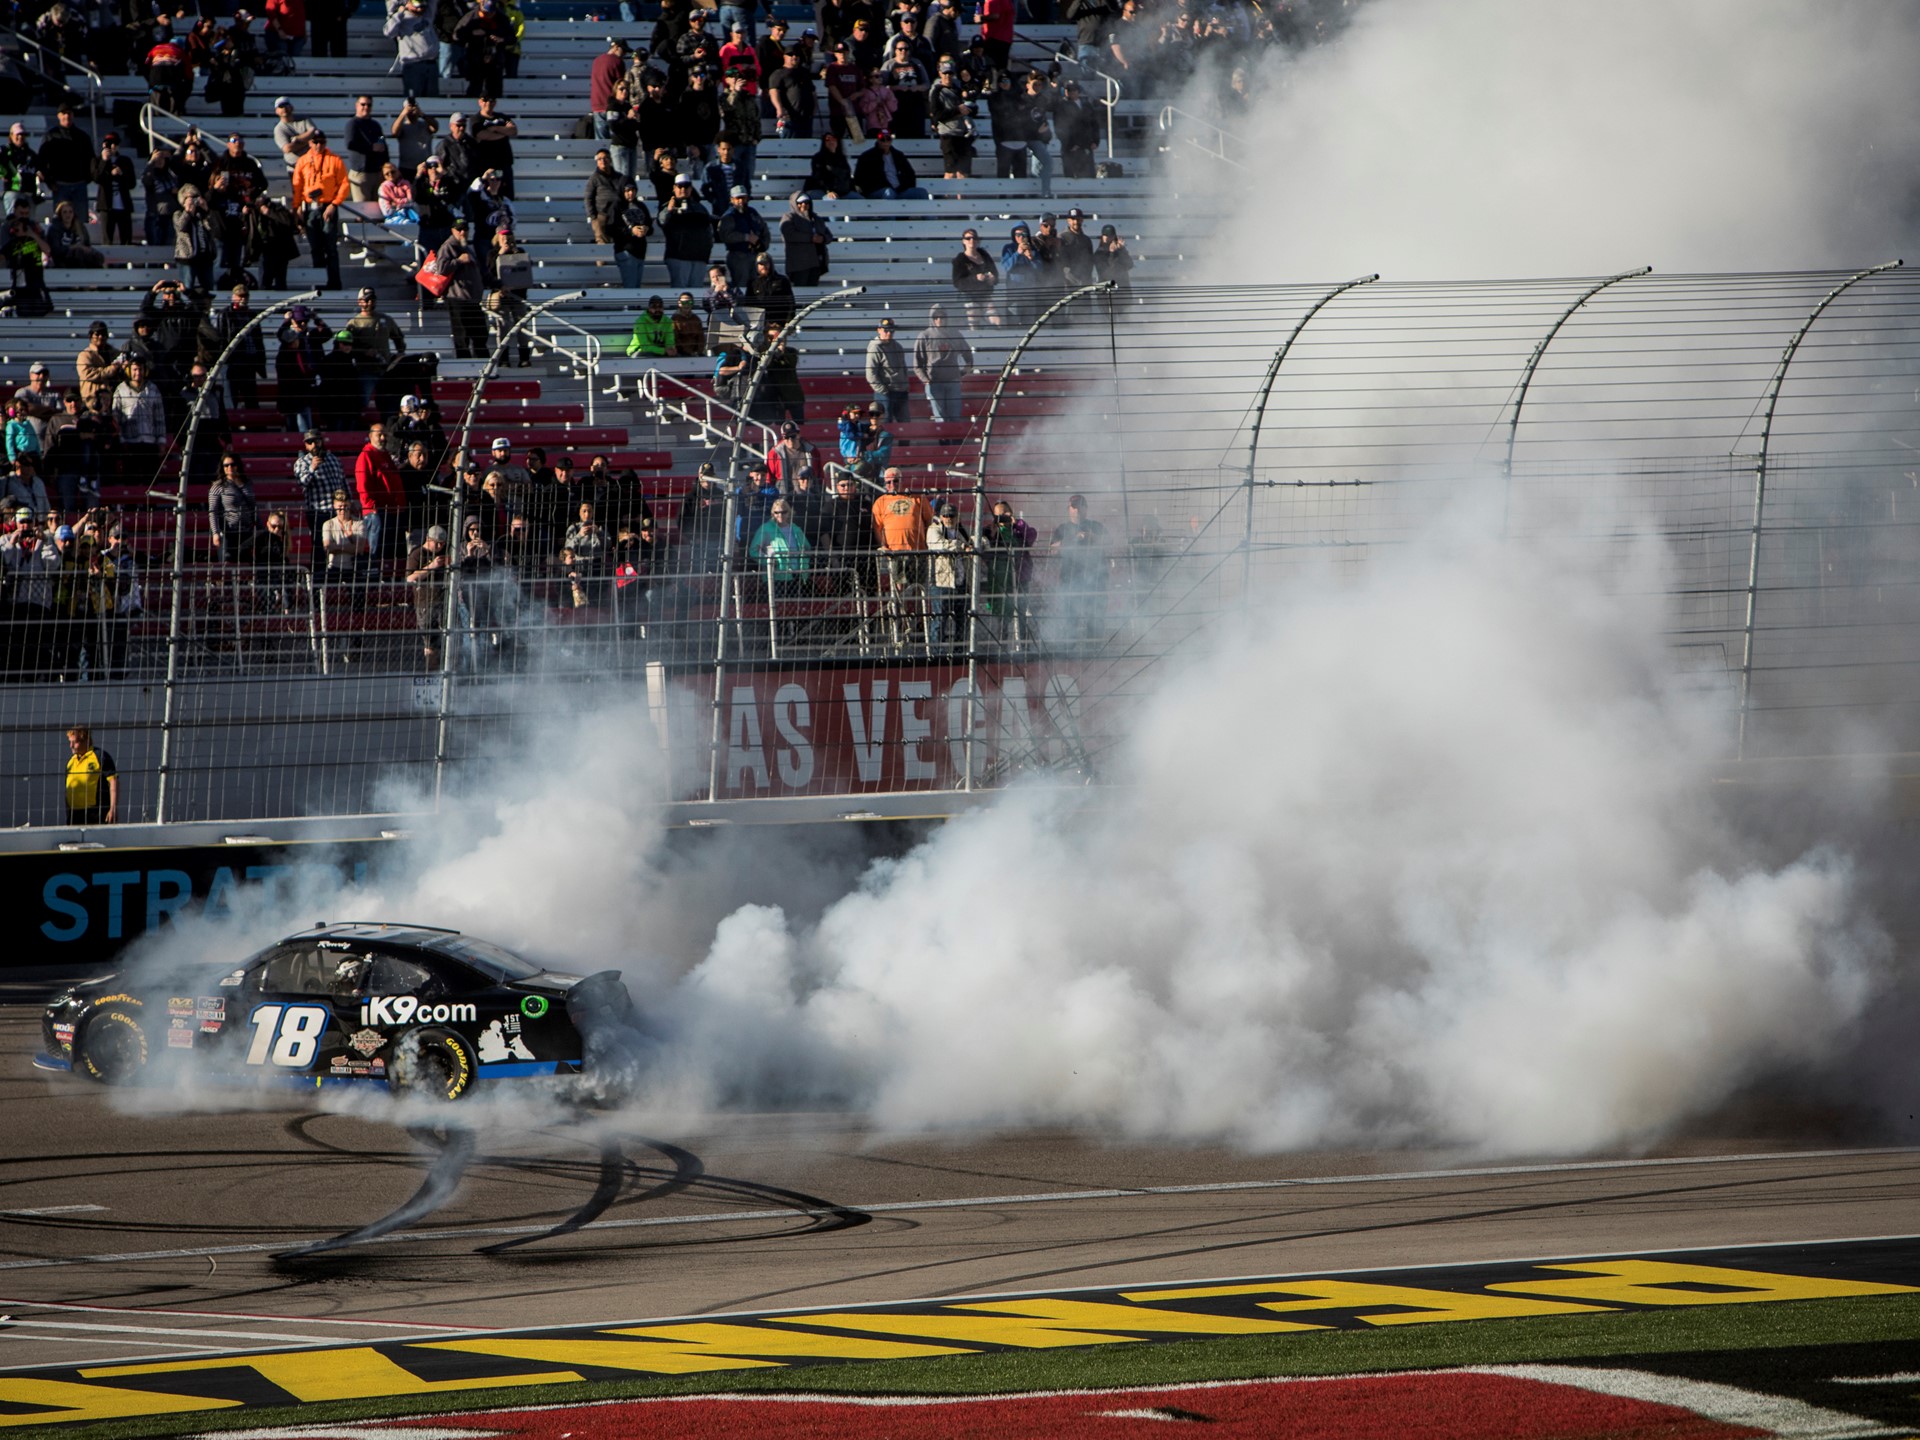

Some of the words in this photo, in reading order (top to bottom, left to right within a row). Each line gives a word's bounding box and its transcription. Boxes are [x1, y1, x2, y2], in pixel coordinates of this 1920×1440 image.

[95, 993, 143, 1006] GOODYEAR
[360, 996, 477, 1026] iK9.com
[246, 1001, 330, 1070] 18
[445, 1037, 470, 1100] GOODYEAR
